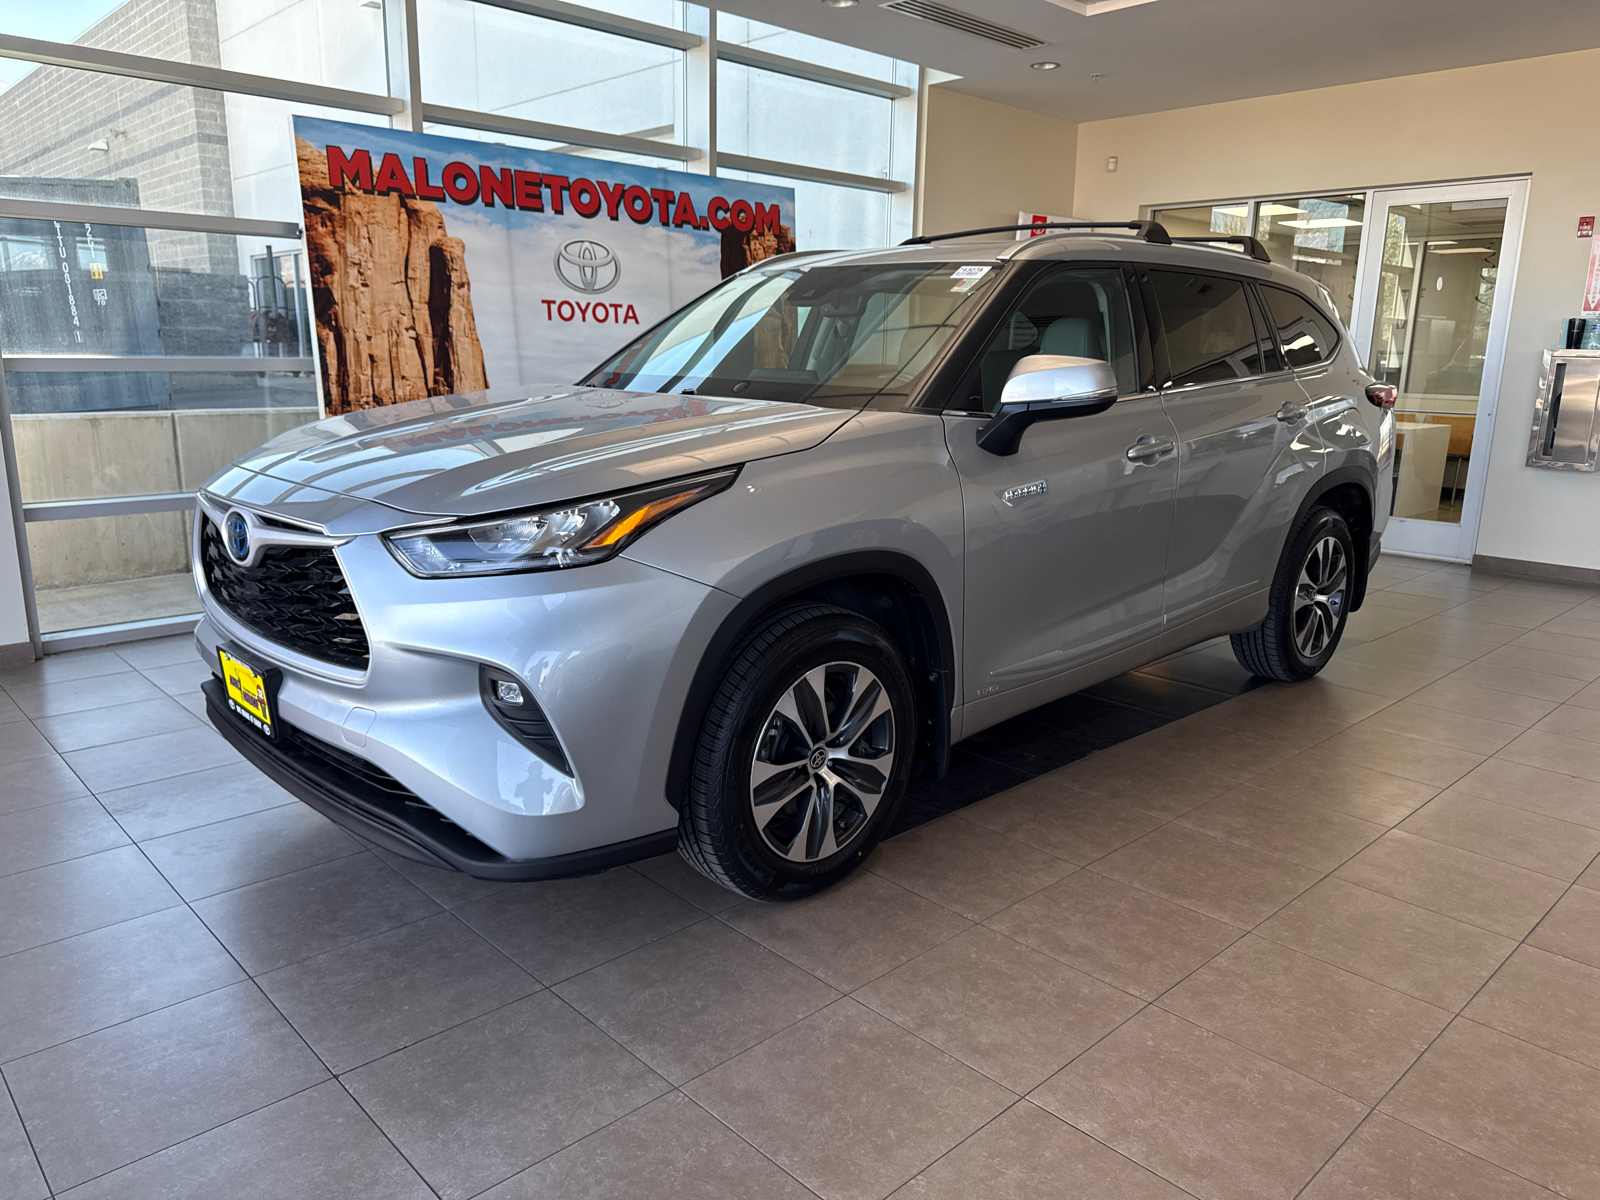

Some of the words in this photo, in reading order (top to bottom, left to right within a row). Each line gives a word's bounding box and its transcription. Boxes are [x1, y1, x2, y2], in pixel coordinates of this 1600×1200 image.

[326, 145, 781, 236] MALONETOYOTA.COM
[85, 224, 95, 258] 2G1
[541, 299, 640, 324] TOYOTA
